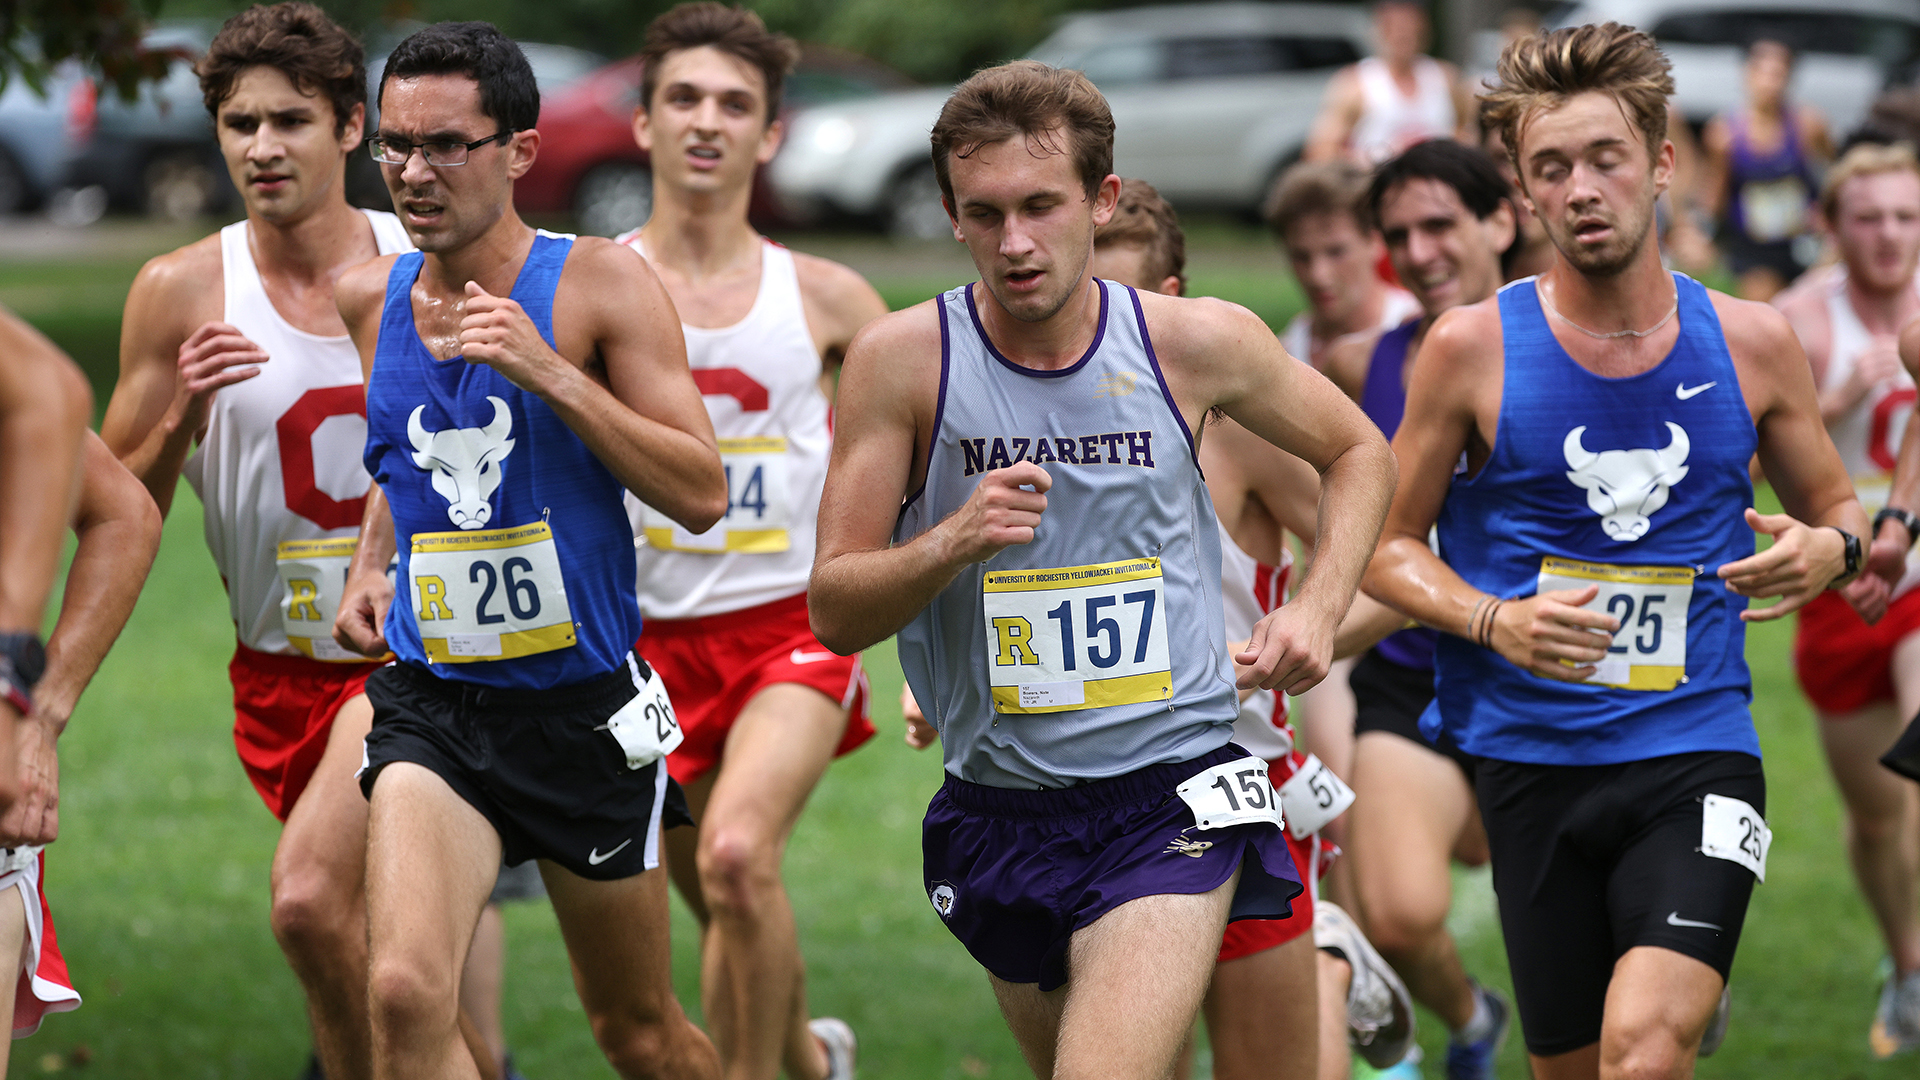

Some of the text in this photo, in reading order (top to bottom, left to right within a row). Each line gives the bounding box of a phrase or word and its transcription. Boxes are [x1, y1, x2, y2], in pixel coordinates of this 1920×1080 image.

[960, 430, 1155, 477] NAZARETH
[415, 556, 541, 625] R 26
[994, 562, 1151, 585] UNIVERSITY OF ROCHESTER YELLOWJACKET INVITATIONAL
[288, 578, 321, 620] R
[992, 589, 1156, 673] R 157
[1607, 593, 1667, 655] 25
[644, 693, 677, 743] 26
[1739, 816, 1762, 861] 25
